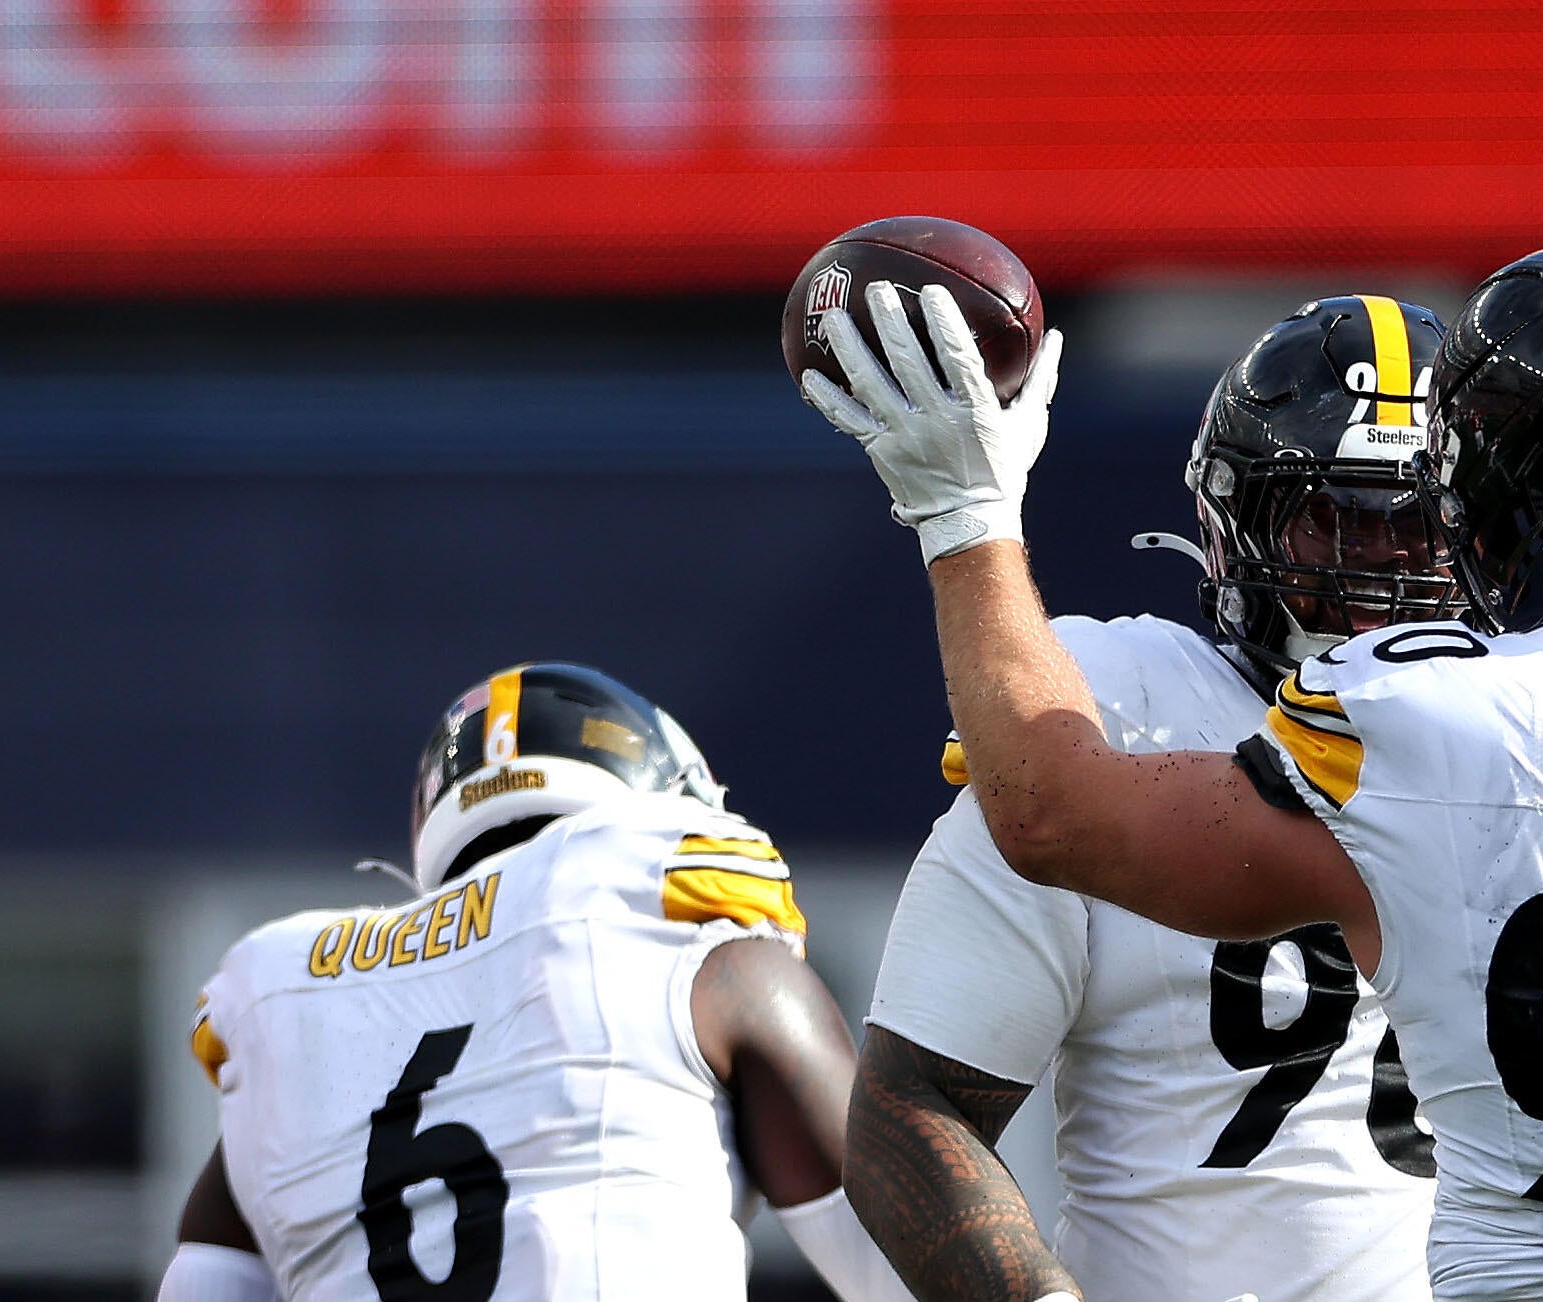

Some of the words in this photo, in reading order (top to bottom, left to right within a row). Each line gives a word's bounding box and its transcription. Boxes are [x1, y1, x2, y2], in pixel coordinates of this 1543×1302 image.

[1367, 428, 1424, 447] Steelers
[486, 713, 517, 764] 6
[309, 871, 502, 979] QUEEN
